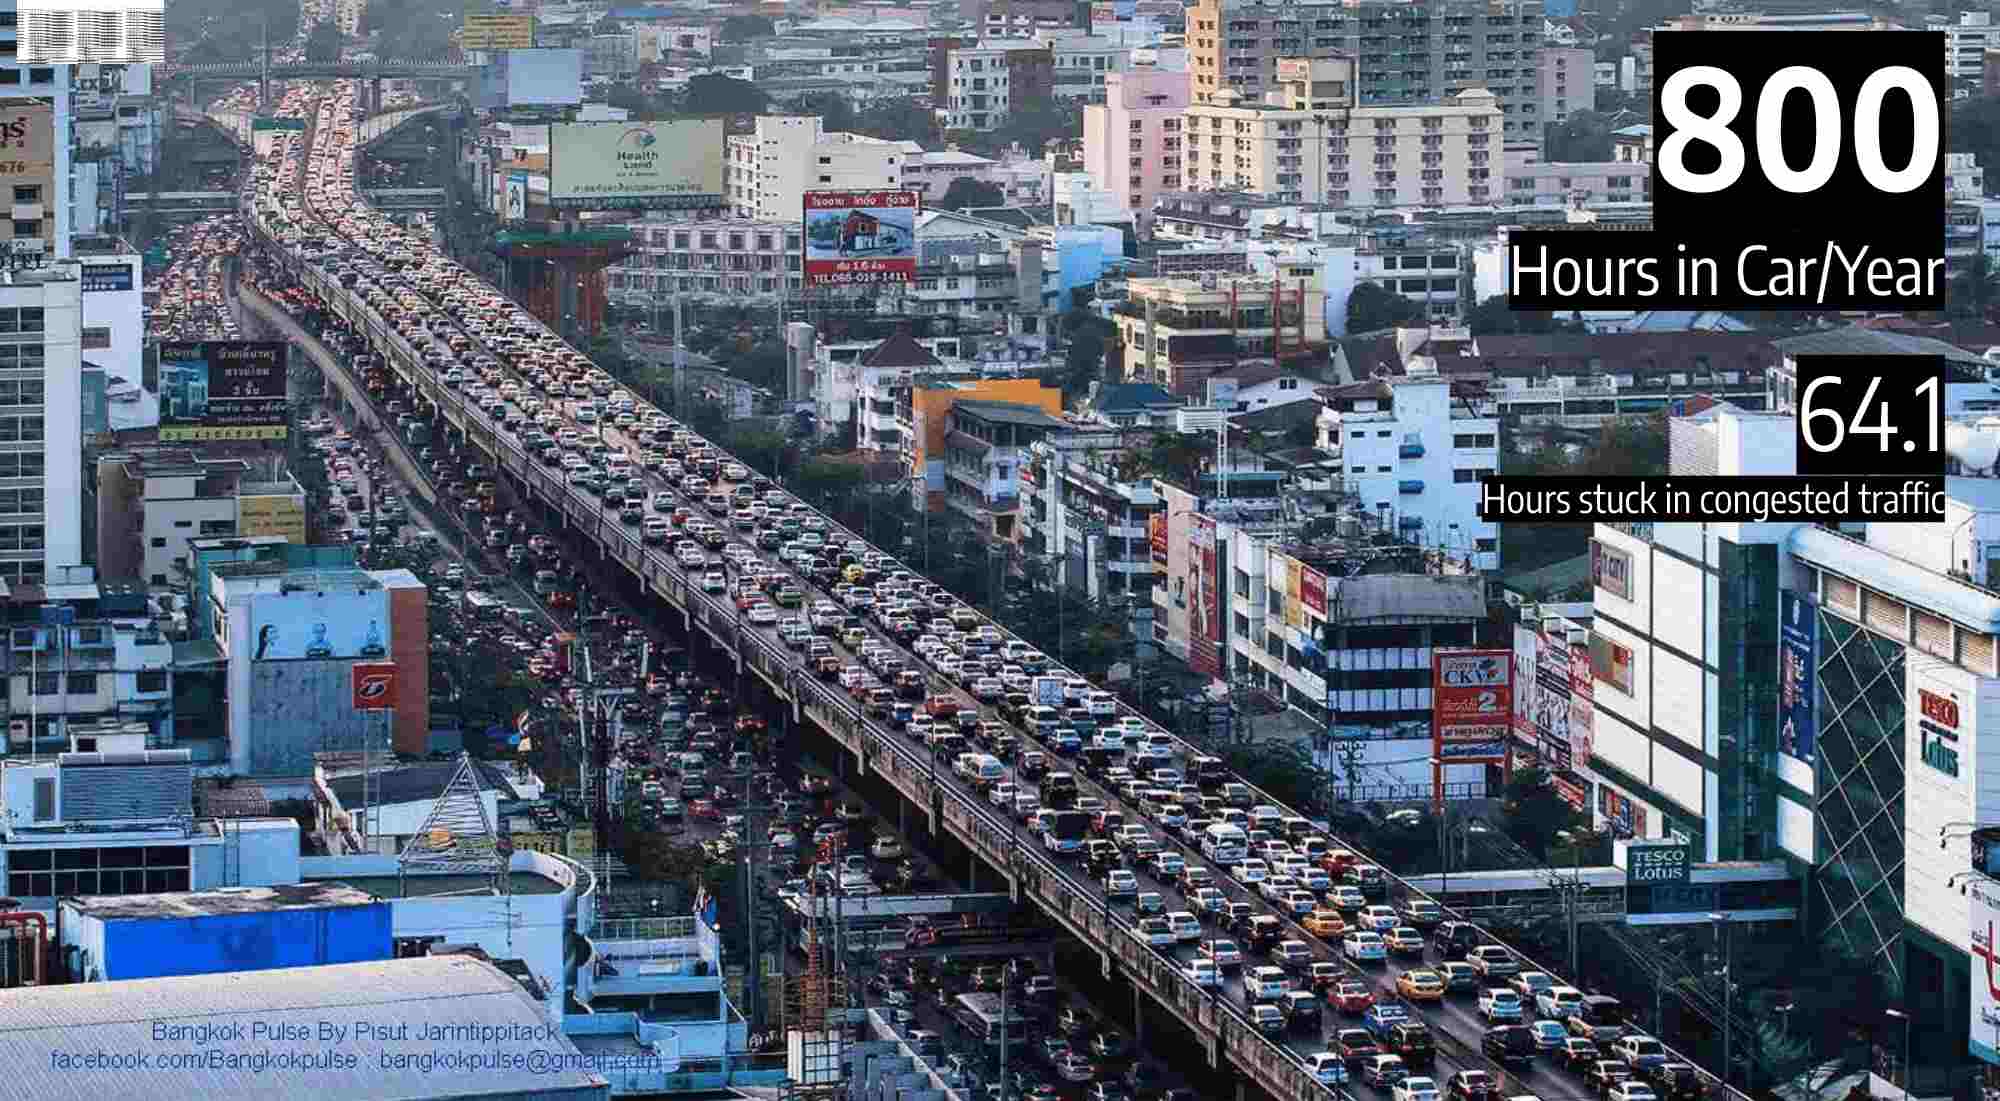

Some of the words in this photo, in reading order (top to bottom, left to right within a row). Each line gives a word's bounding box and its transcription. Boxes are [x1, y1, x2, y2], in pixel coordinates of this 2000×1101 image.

[617, 151, 659, 161] Health
[1478, 692, 1497, 713] 2
[1918, 687, 1959, 730] TESCO
[1920, 730, 1959, 778] Lotus
[1632, 850, 1685, 862] TESCO
[1634, 867, 1683, 880] Lotus
